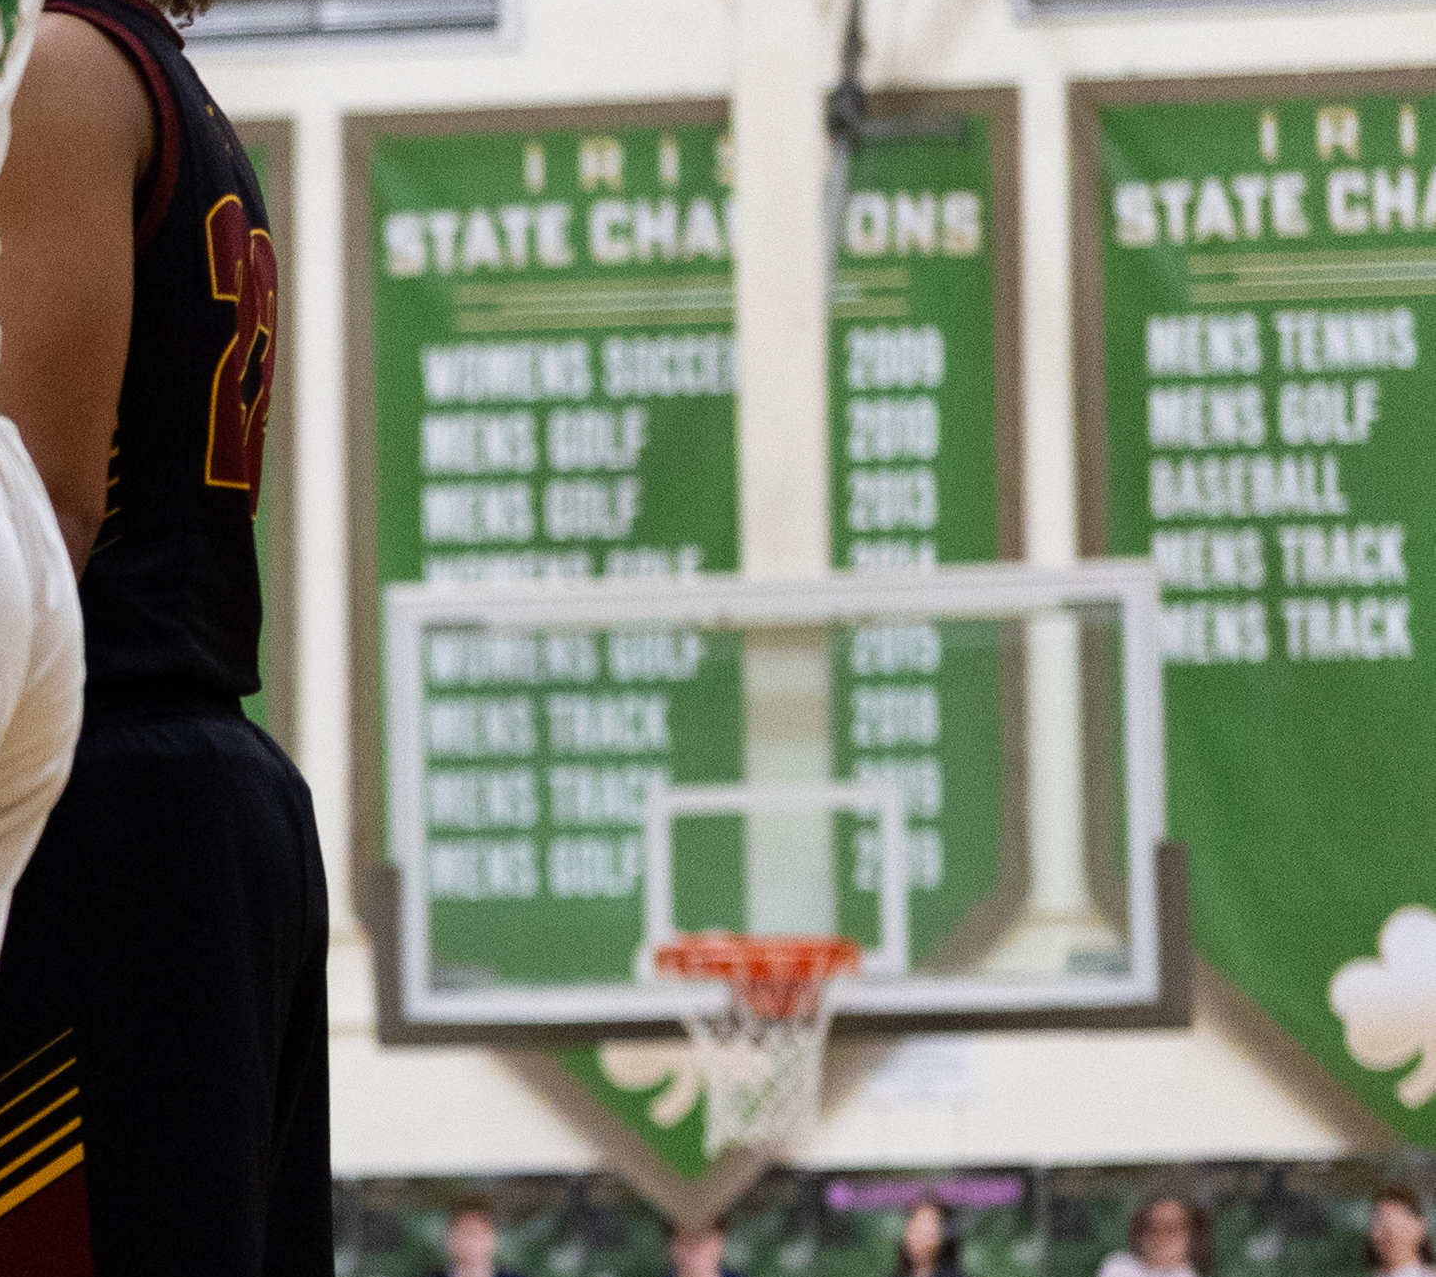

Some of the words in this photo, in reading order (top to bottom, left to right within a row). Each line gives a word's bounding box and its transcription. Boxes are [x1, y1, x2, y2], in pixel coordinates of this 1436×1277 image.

[384, 200, 572, 278] STATE
[592, 190, 983, 266] CHAONS
[1113, 170, 1311, 248] STATE
[423, 340, 590, 405] WOMENS
[1146, 311, 1263, 376] MENS
[1275, 306, 1418, 370] TENNIS
[422, 410, 536, 474] MENS
[546, 404, 649, 472] GOLF
[1148, 383, 1265, 450] MENS
[1278, 377, 1381, 446] GOLF
[422, 480, 534, 544] MENS
[543, 474, 642, 541] GOLF
[1149, 451, 1351, 521] BASEBALL
[1151, 527, 1266, 592] MENS
[1278, 523, 1409, 589] TRACK
[1159, 597, 1269, 665] MENS
[1281, 595, 1415, 662] TRACK
